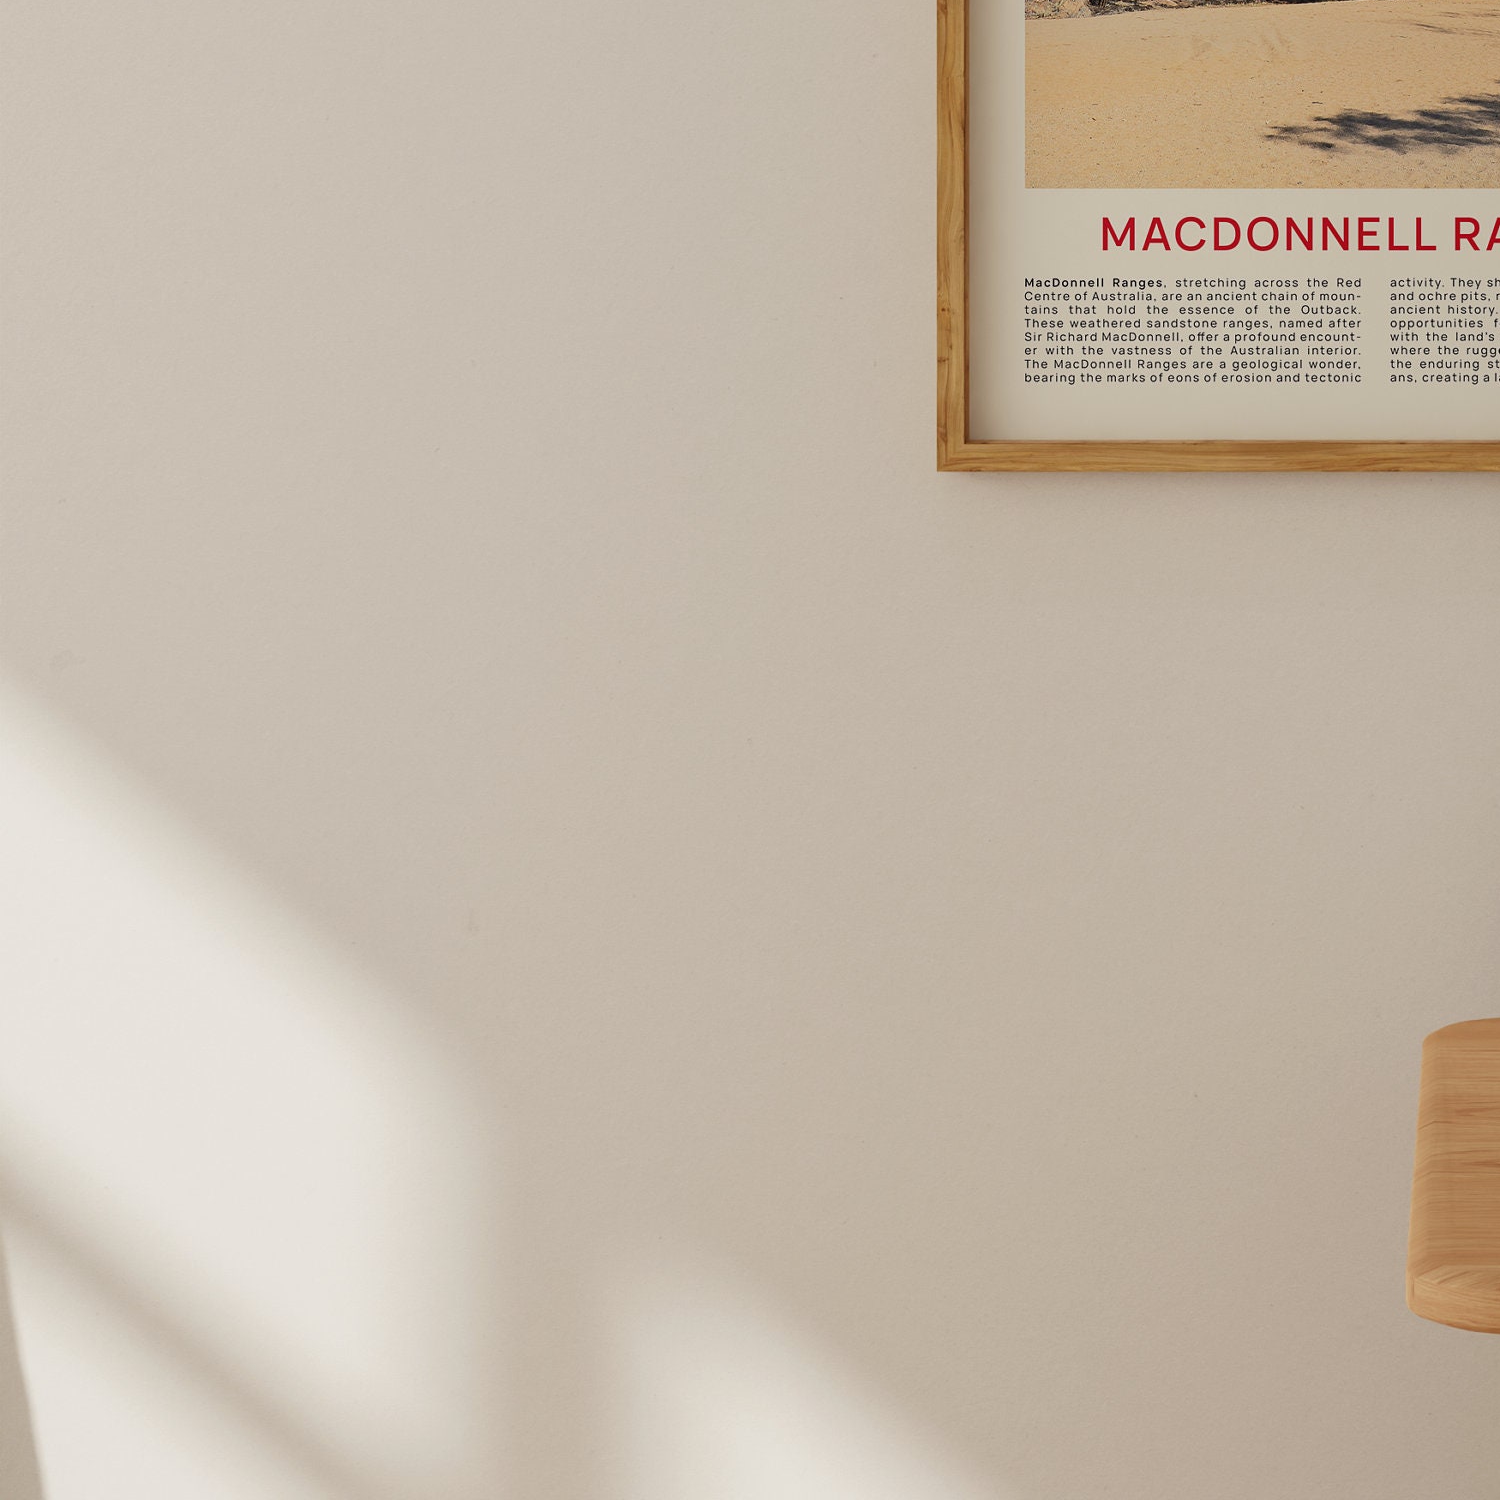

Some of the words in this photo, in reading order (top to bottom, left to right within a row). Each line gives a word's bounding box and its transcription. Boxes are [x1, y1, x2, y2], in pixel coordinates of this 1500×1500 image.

[1102, 216, 1437, 252] MACDONNELL
[1025, 278, 1103, 287] MacDonnell
[1113, 278, 1166, 290] Ranges,
[1176, 278, 1245, 290] stretching
[1307, 278, 1328, 287] the
[1337, 278, 1361, 287] Red
[1391, 278, 1444, 289] activity.
[1451, 278, 1481, 289] They
[1025, 291, 1069, 301] Centre
[1075, 291, 1087, 301] of
[1092, 292, 1156, 301] Australia,
[1207, 292, 1257, 301] ancient
[1262, 292, 1297, 301] chain
[1302, 291, 1315, 301] of
[1390, 292, 1413, 300] and
[1419, 292, 1456, 300] ochre
[1461, 292, 1490, 303] pits,
[1025, 305, 1058, 314] tains
[1069, 305, 1096, 314] that
[1108, 305, 1135, 314] hold
[1147, 305, 1168, 314] the
[1245, 305, 1258, 314] of
[1269, 305, 1290, 314] the
[1301, 305, 1360, 314] Outback.
[1025, 319, 1063, 328] These
[1070, 319, 1140, 328] weathered
[1147, 319, 1217, 328] sandstone
[1224, 320, 1272, 330] ranges,
[1280, 319, 1322, 328] named
[1329, 319, 1361, 328] after
[1025, 332, 1042, 341] Sir
[1047, 332, 1097, 341] Richard
[1102, 332, 1183, 342] MacDonnell,
[1189, 332, 1218, 341] offer
[1235, 332, 1295, 344] profound
[1300, 333, 1360, 341] encount-
[1046, 346, 1073, 355] with
[1082, 346, 1103, 355] the
[1112, 346, 1171, 355] vastness
[1180, 346, 1192, 355] of
[1201, 346, 1222, 355] the
[1231, 346, 1299, 355] Australian
[1308, 346, 1360, 355] interior.
[1025, 360, 1047, 369] The
[1054, 360, 1131, 369] MacDonnell
[1138, 360, 1186, 371] Ranges
[1193, 361, 1213, 369] are
[1232, 360, 1302, 371] geological
[1309, 360, 1360, 369] wonder,
[1025, 373, 1075, 385] bearing
[1081, 373, 1102, 382] the
[1107, 373, 1145, 382] marks
[1150, 373, 1163, 382] of
[1204, 373, 1216, 382] of
[1222, 373, 1271, 382] erosion
[1277, 373, 1300, 382] and
[1306, 373, 1361, 382] tectonic
